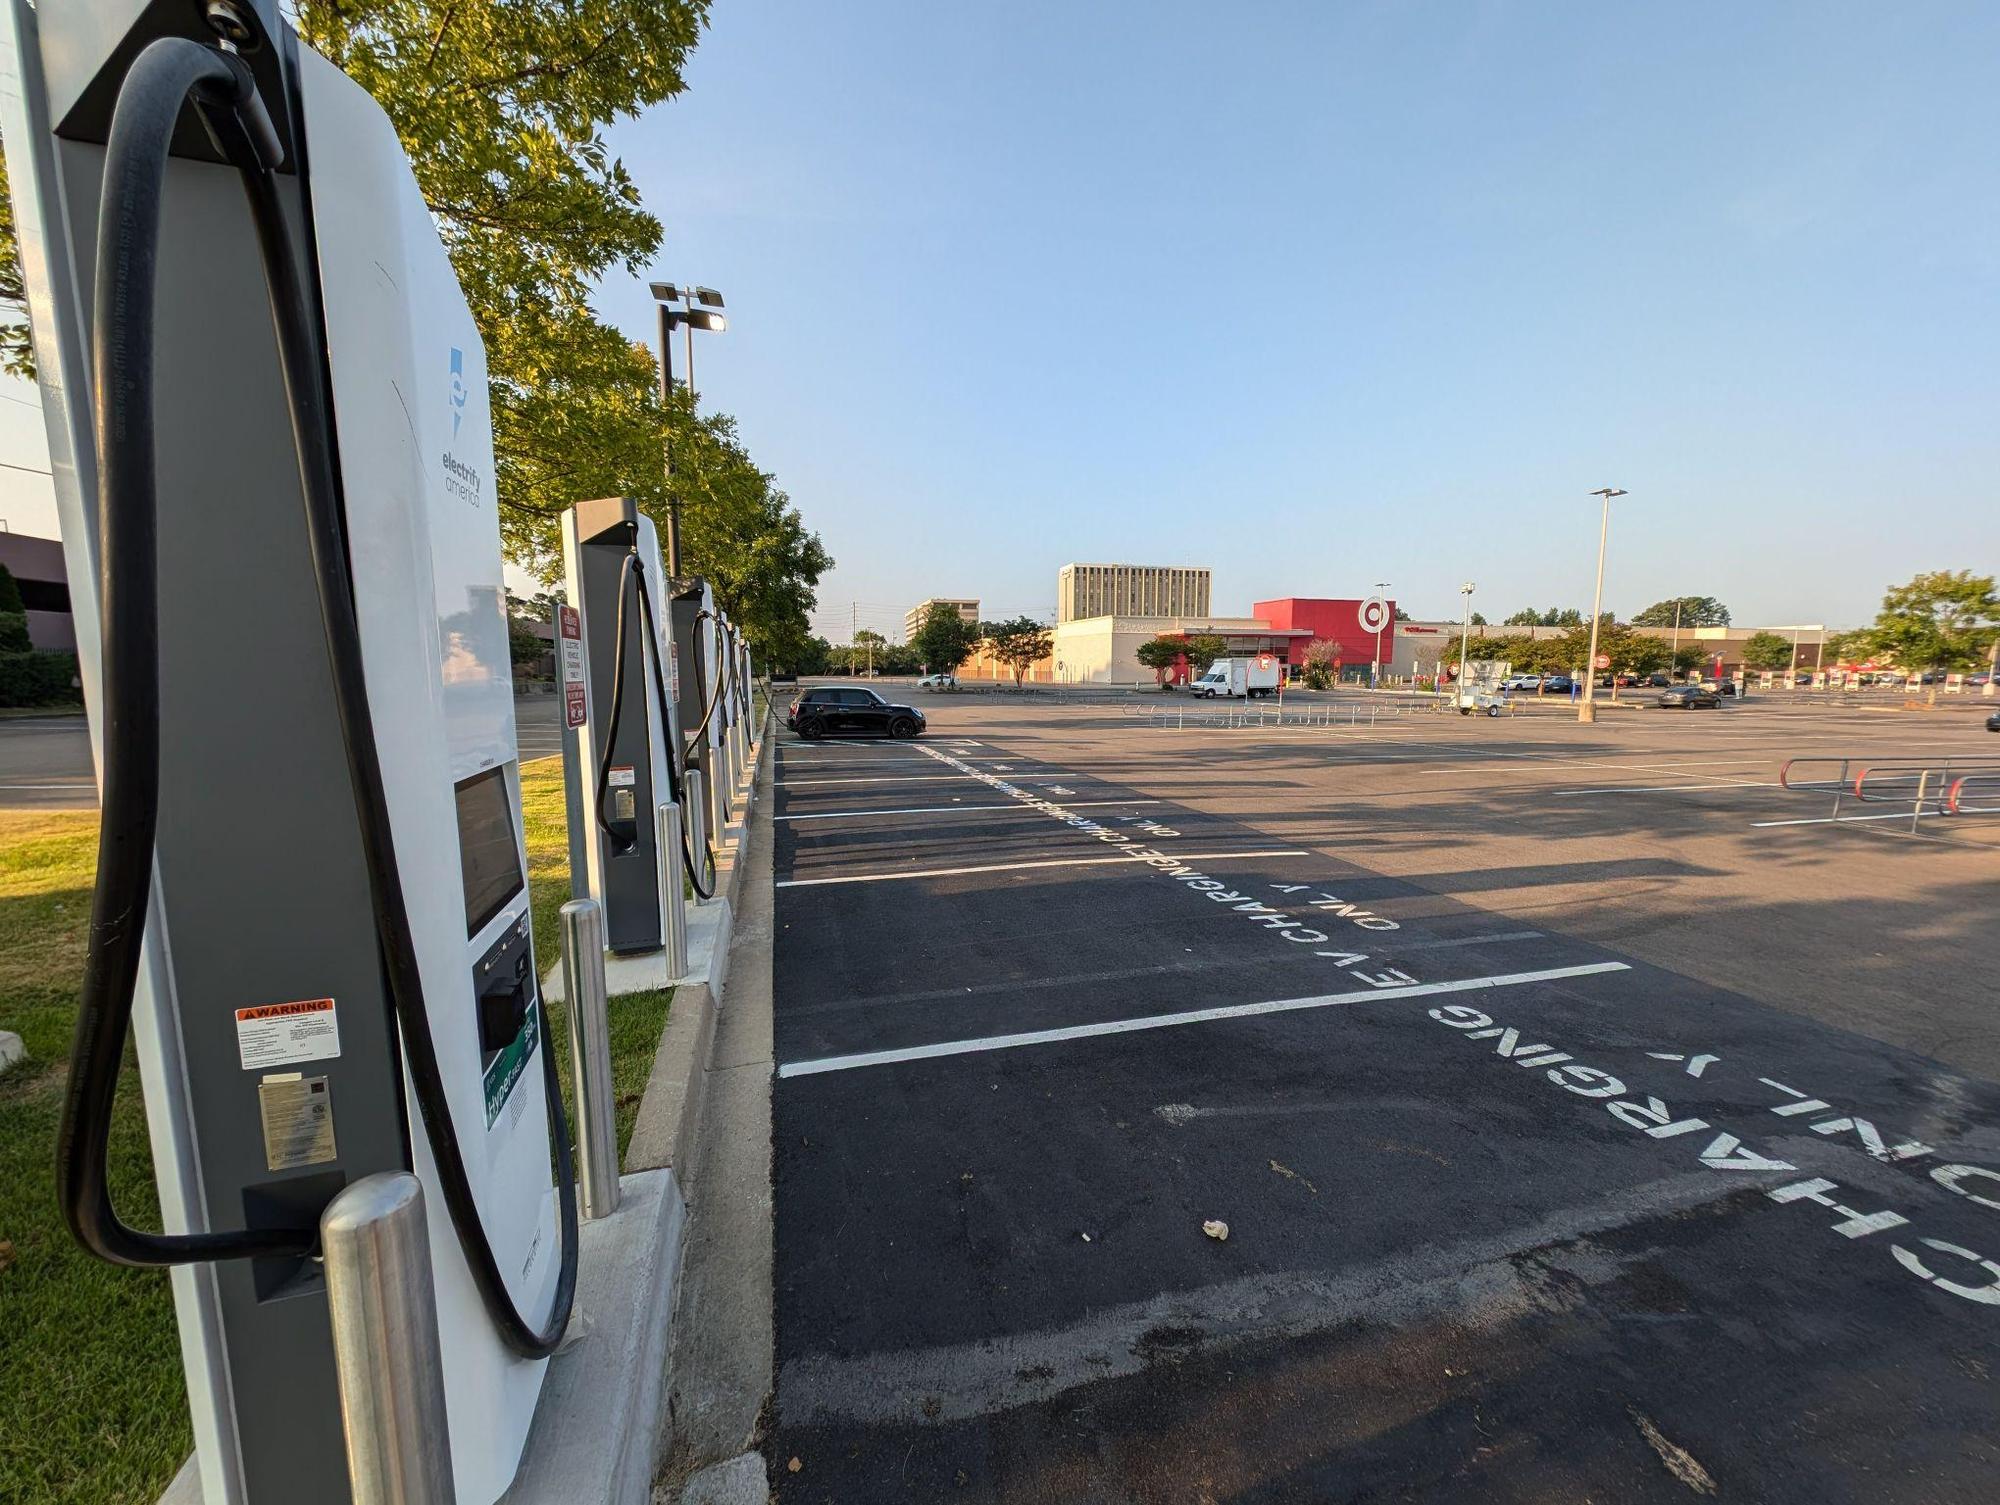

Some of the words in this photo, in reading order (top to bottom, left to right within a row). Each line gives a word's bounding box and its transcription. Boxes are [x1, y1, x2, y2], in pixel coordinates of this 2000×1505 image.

[442, 450, 481, 493] electrify
[445, 476, 480, 508] america
[1146, 857, 1329, 943] CHARGING
[1268, 884, 1400, 931] ONLY
[1313, 950, 1420, 988] EV
[254, 1001, 328, 1017] WARNING
[1645, 1051, 2000, 1210] ONLY
[1428, 1004, 2000, 1306] CHARGING
